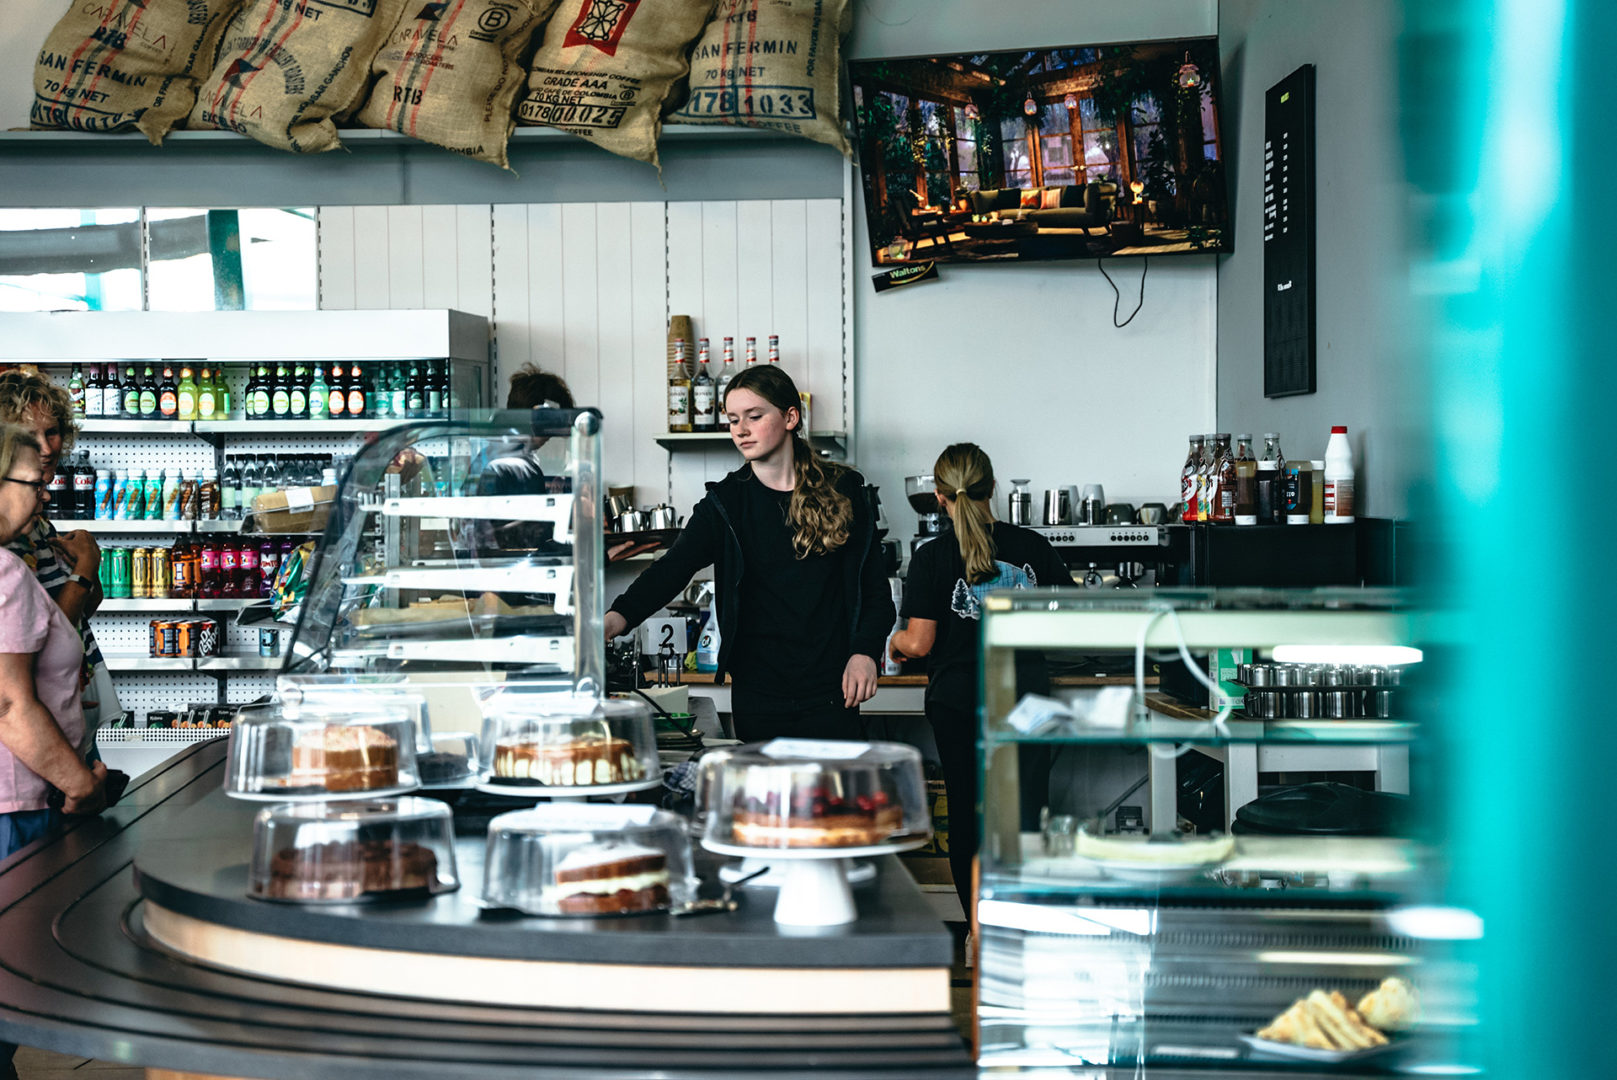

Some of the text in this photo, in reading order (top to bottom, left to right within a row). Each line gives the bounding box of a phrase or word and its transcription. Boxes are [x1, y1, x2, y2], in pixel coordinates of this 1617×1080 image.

[295, 2, 323, 20] NET
[695, 40, 797, 60] SAN FERMIN
[40, 51, 147, 87] SAN FERMIN
[705, 69, 718, 79] 70
[738, 66, 766, 78] NET
[44, 80, 60, 92] 70
[79, 88, 110, 103] NET
[544, 77, 608, 89] GRADE AAA
[521, 104, 550, 119] 0178
[889, 265, 926, 279] Waltons
[661, 624, 674, 648] 2
